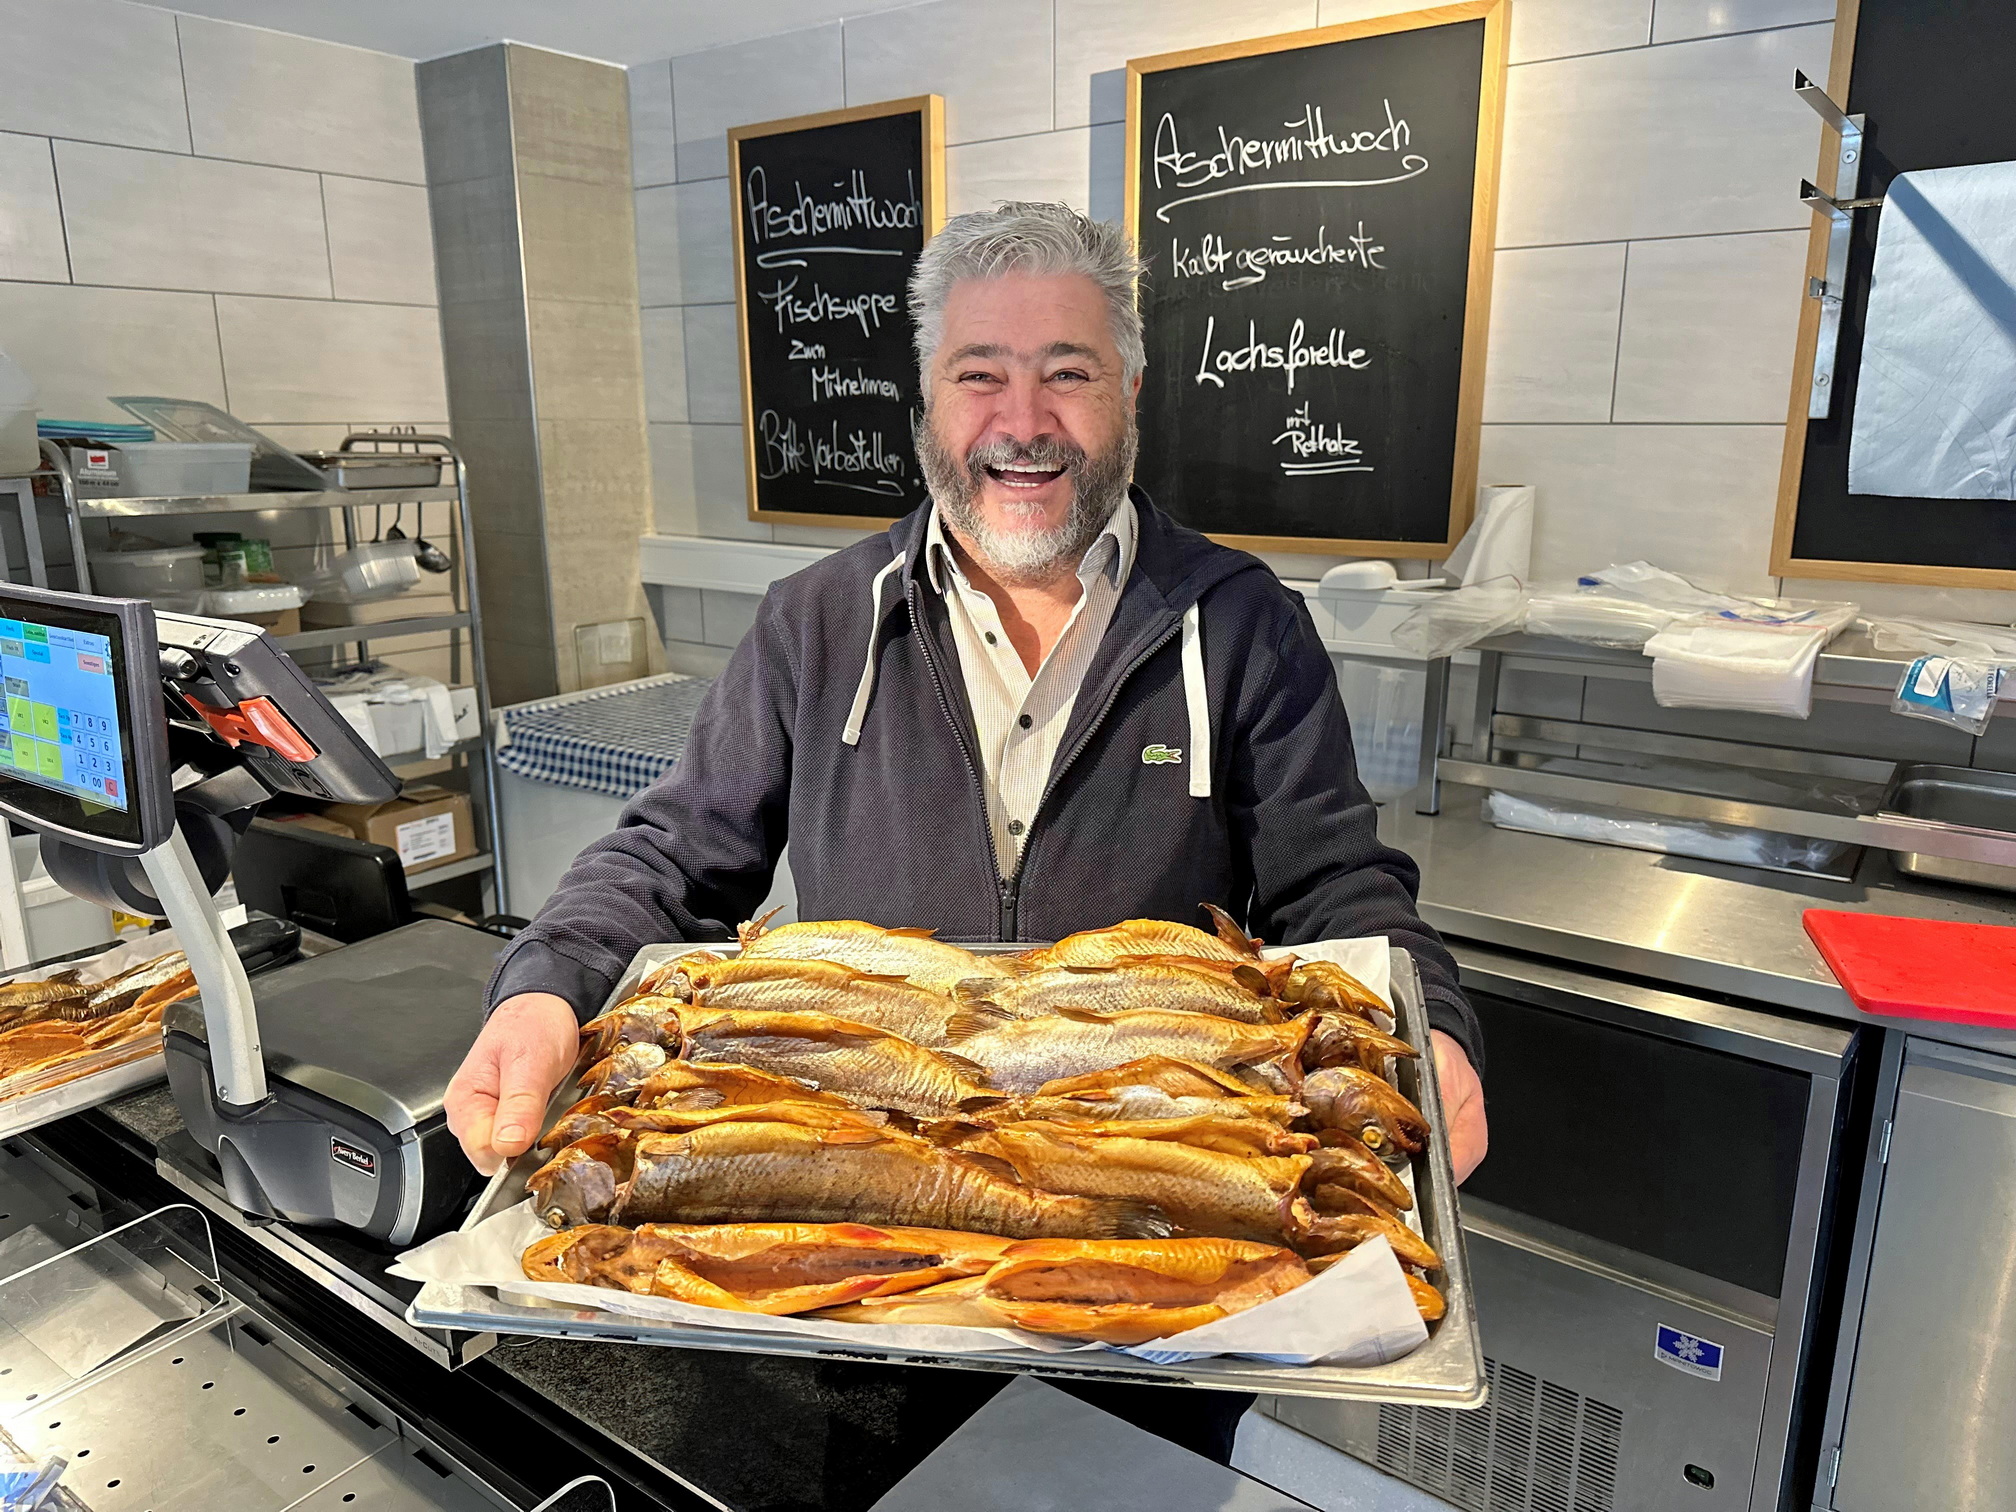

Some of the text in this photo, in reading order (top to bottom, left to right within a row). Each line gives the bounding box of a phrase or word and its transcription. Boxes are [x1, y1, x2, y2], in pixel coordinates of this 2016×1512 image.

[1154, 98, 1410, 189] Aschermittwoch
[758, 275, 899, 339] Fischsuppe
[1195, 315, 1373, 396] Lachsforelle
[811, 364, 900, 403] Mitnehmen
[1286, 400, 1312, 430] mit
[760, 409, 809, 480] Bitte
[74, 714, 79, 724] 7
[87, 717, 93, 728] 8
[101, 721, 107, 731] 9
[76, 734, 82, 745] 4
[90, 738, 95, 748] 5
[104, 741, 109, 752] 6
[78, 754, 111, 772] 1 2 3
[81, 774, 114, 792] 0 00 C
[337, 1146, 369, 1166] Avery Berkel
[1668, 1355, 1712, 1376] MANITOWOC
